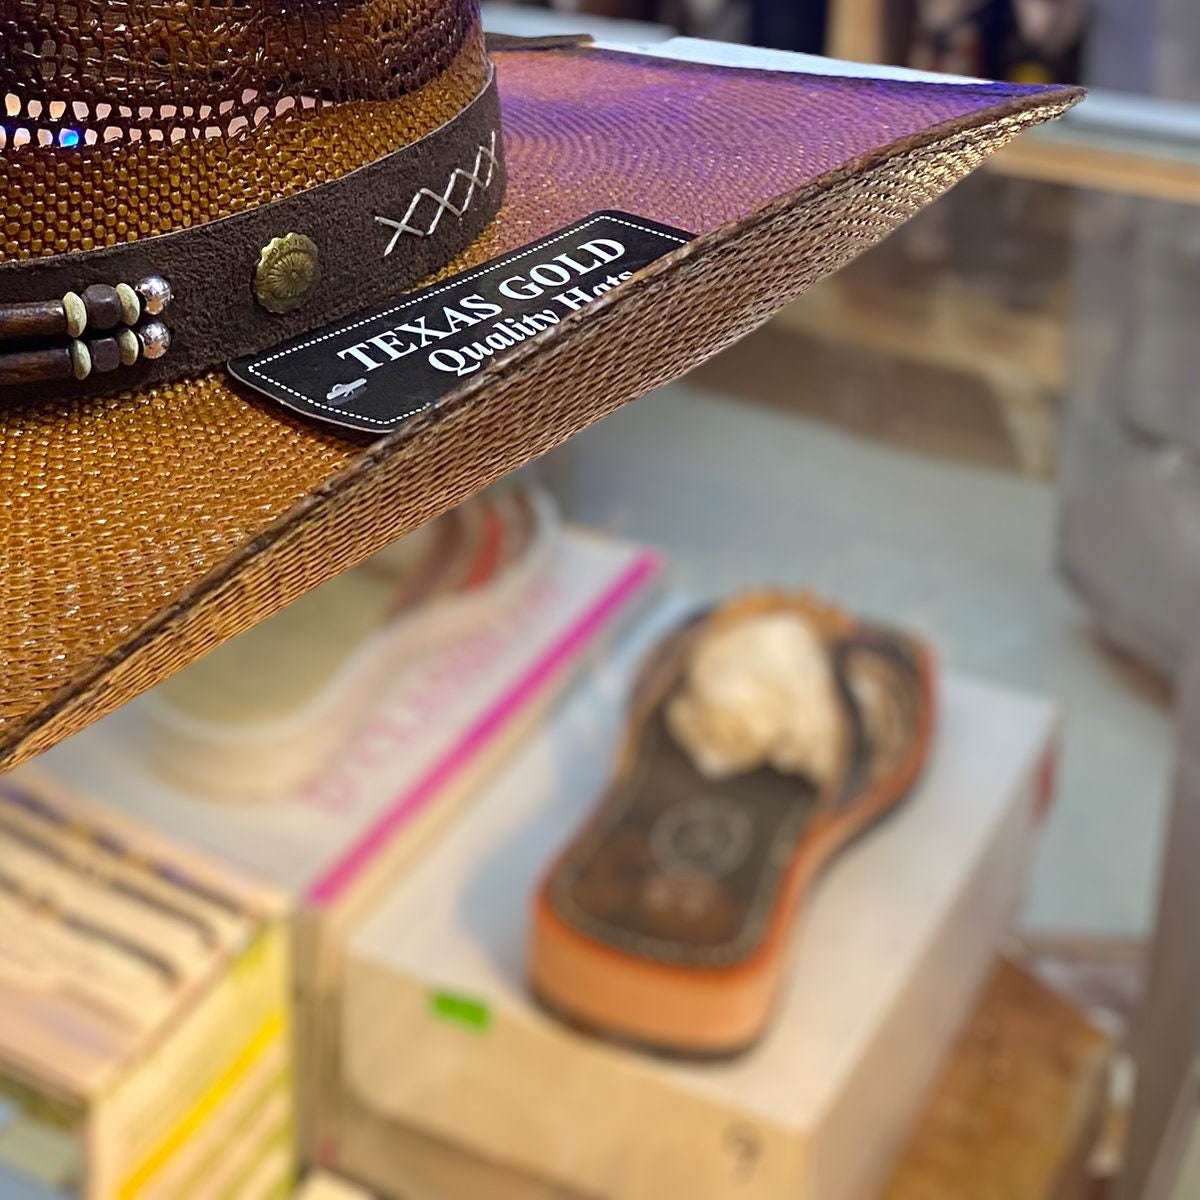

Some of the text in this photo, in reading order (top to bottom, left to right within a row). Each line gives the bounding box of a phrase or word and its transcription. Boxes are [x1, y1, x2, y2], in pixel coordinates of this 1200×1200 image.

[336, 238, 626, 373] TEXAS GOLD
[428, 308, 561, 377] Quality
